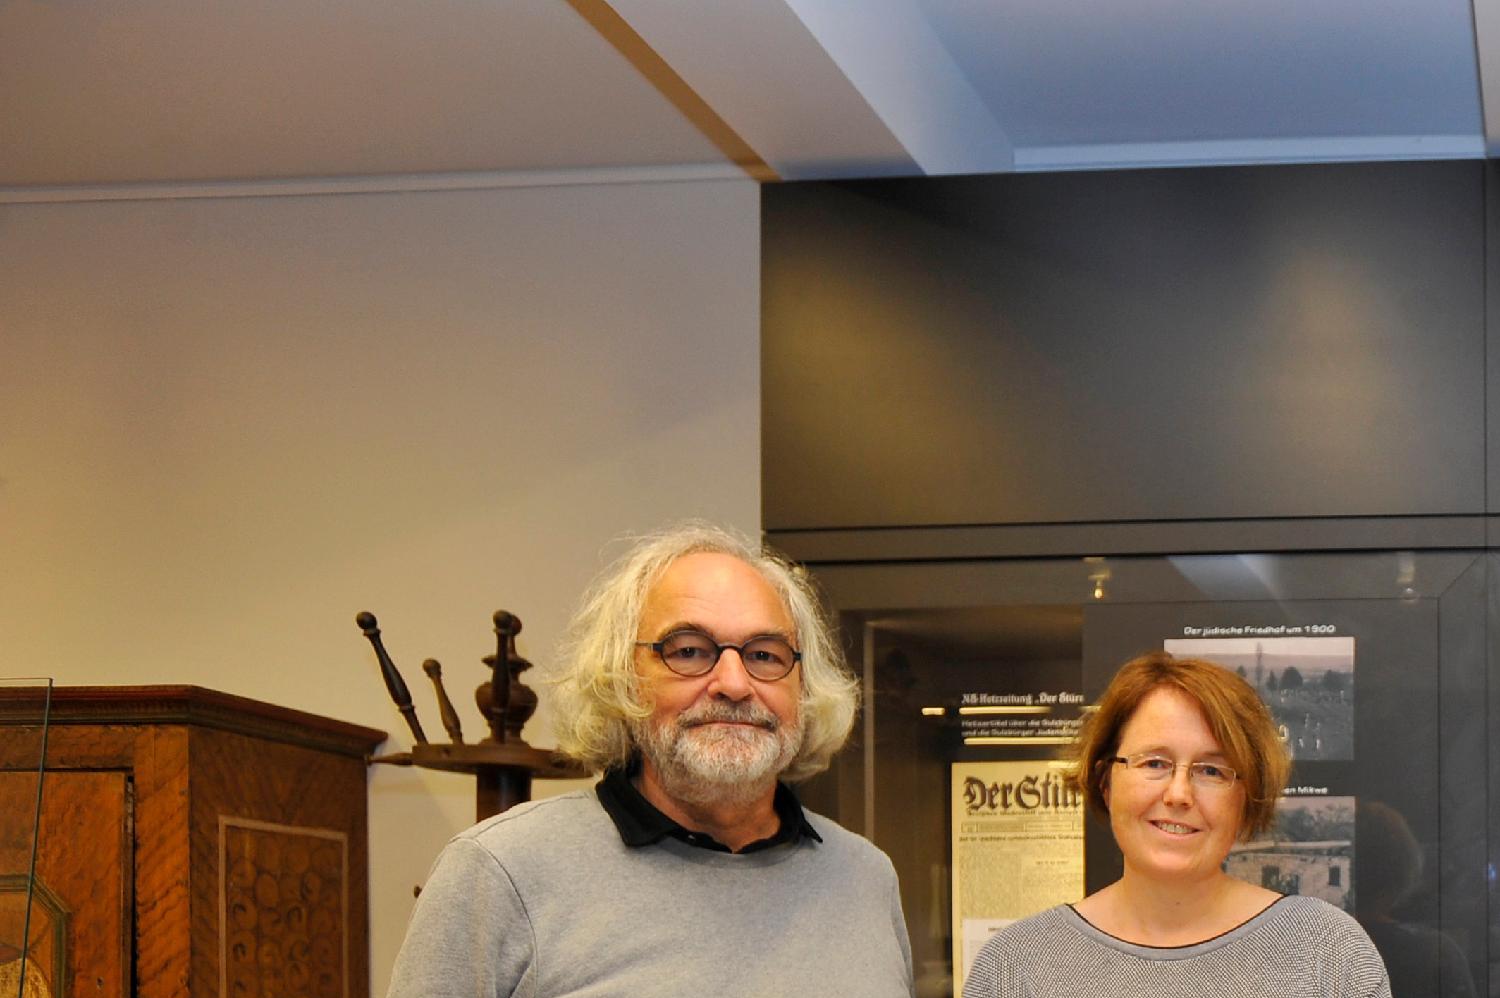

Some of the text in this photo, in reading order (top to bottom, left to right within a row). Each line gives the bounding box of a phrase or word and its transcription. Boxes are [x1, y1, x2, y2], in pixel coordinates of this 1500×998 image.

[1183, 626, 1200, 635] Der
[1203, 625, 1242, 637] jüdische
[1244, 625, 1285, 634] Friedhof
[1305, 624, 1337, 633] 1900
[963, 776, 1013, 810] Der
